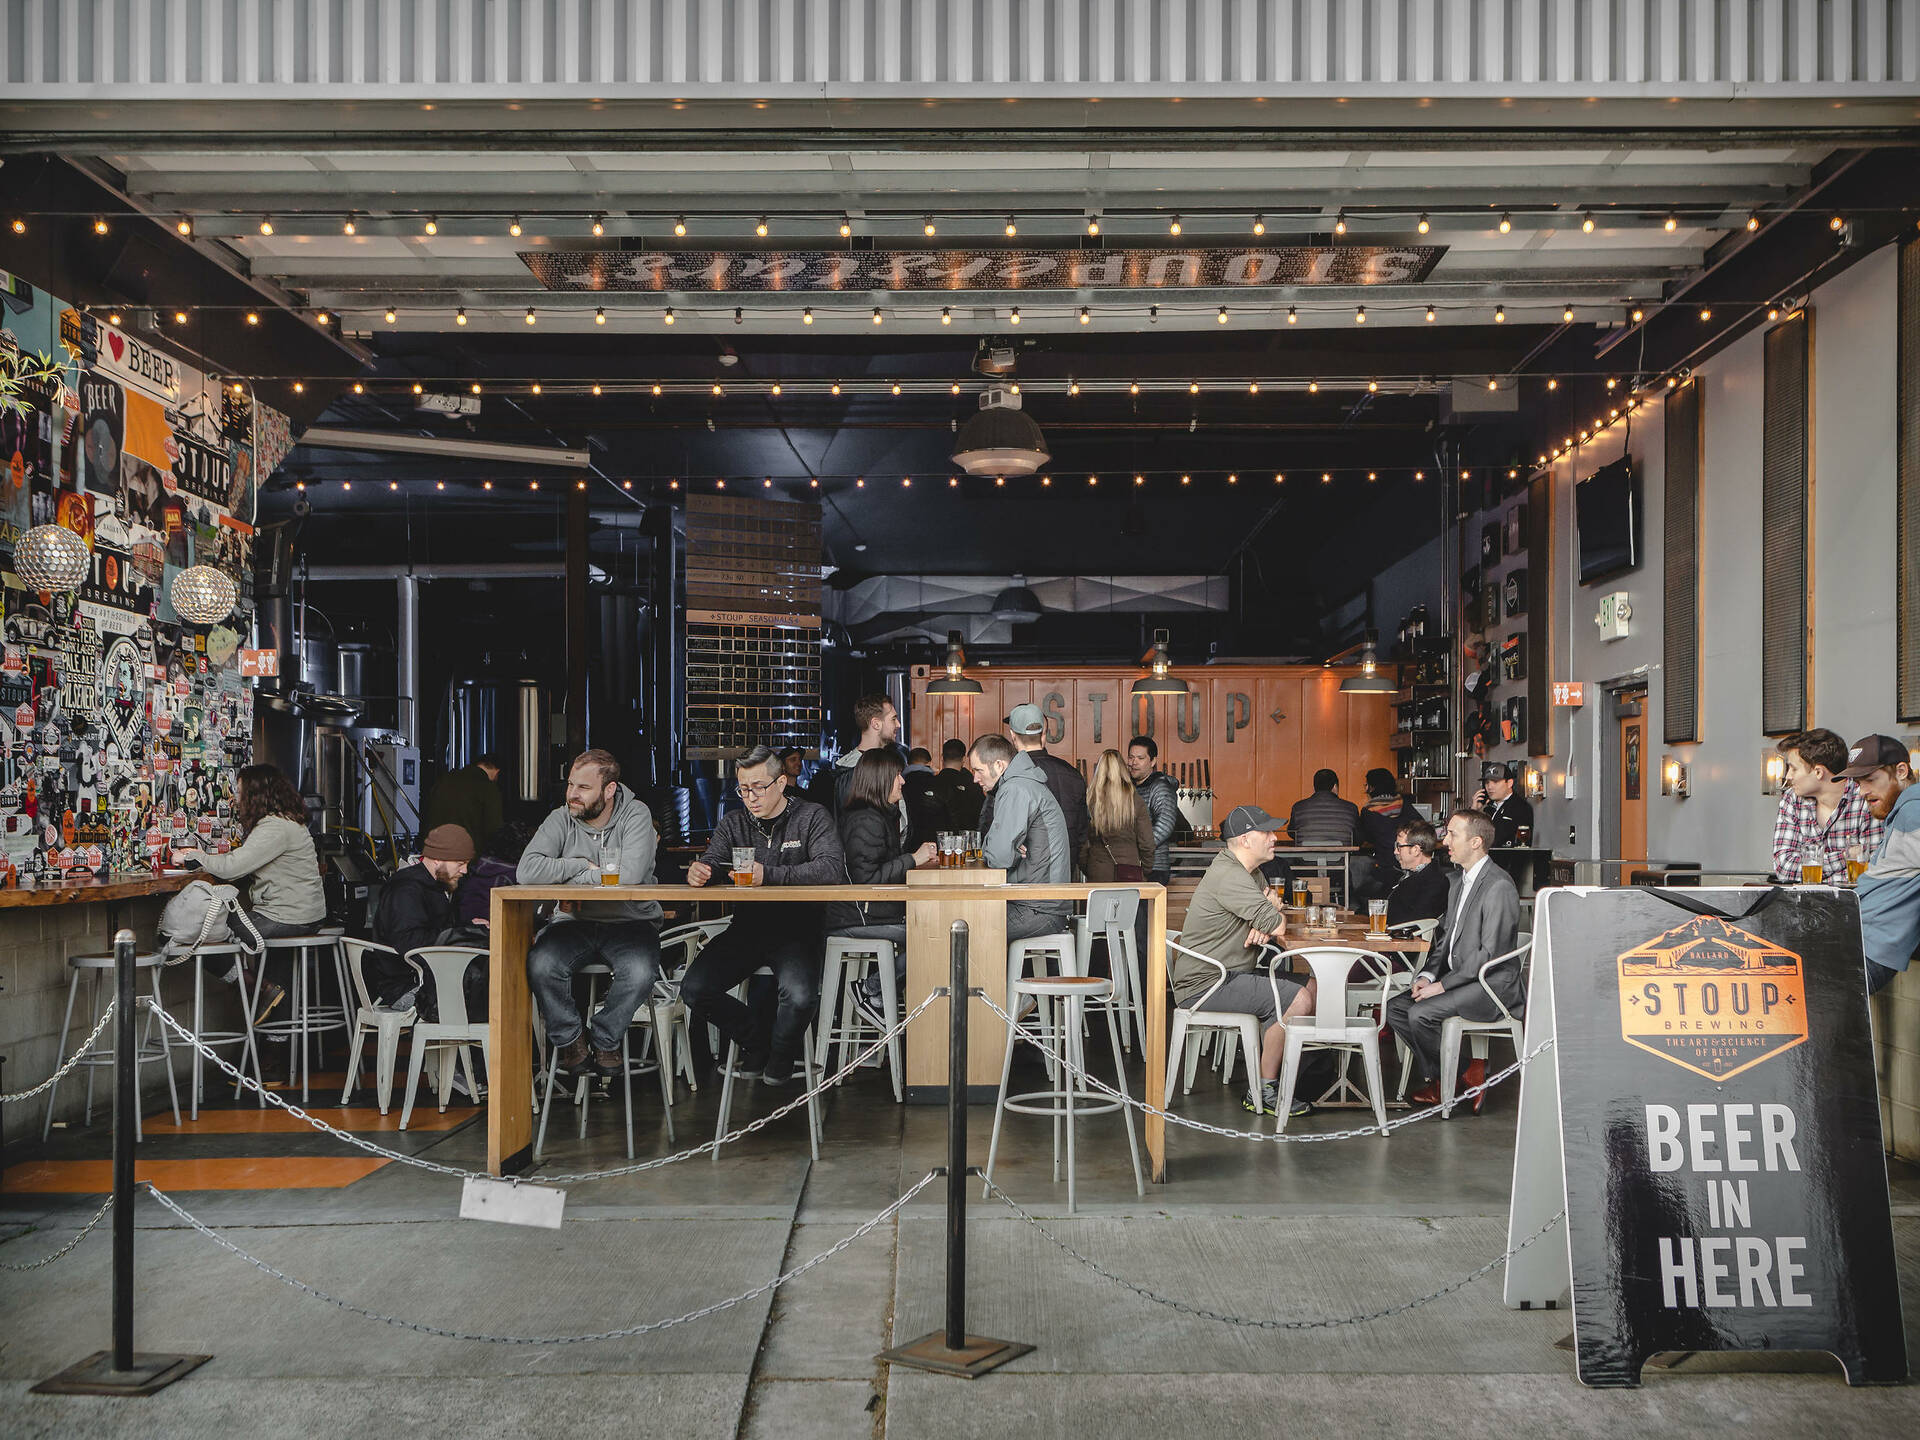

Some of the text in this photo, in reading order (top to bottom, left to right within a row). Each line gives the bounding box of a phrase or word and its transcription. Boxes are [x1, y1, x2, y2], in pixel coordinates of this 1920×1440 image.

[97, 324, 175, 392] I BEER
[84, 381, 117, 416] BEER
[178, 442, 230, 491] STOUP
[748, 615, 793, 624] SEASONALS
[61, 652, 81, 672] PALE
[82, 655, 95, 674] ALE
[60, 682, 95, 710] PILSENER
[1045, 692, 1251, 743] STOUP
[1643, 982, 1779, 1016] STOUP
[1665, 1021, 1765, 1030] BREWING
[1666, 1038, 1686, 1047] THE
[1689, 1038, 1708, 1047] ART
[1695, 1048, 1738, 1057] OF BEER
[1645, 1103, 1801, 1172] BEER
[1706, 1180, 1751, 1229] IN
[1658, 1237, 1813, 1308] HERE
